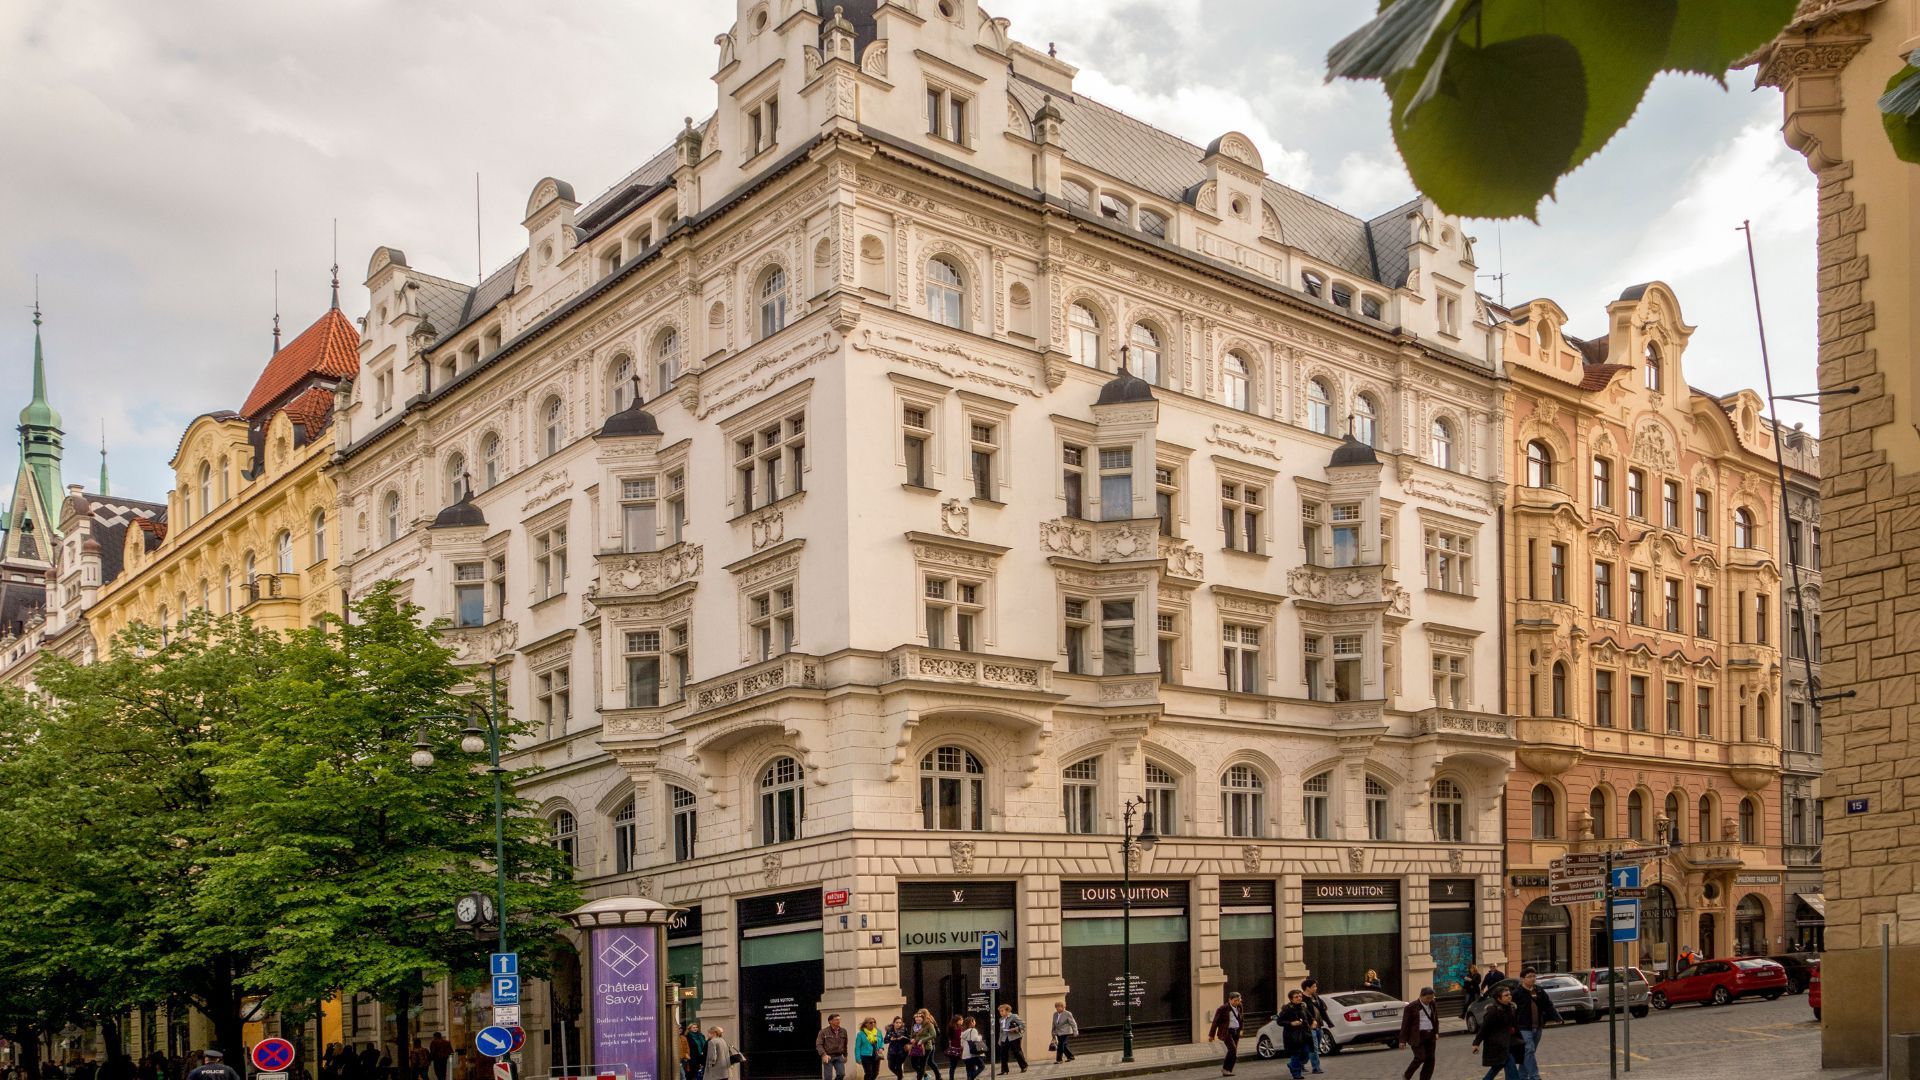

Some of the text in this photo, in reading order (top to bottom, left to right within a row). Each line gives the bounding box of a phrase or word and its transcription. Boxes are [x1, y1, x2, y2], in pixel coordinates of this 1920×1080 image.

[1851, 801, 1863, 811] 15
[1081, 887, 1169, 900] LOUIS VUITTON
[1316, 885, 1383, 897] LOUIS VUITTON
[906, 930, 1009, 945] LOUIS VUITN
[984, 938, 996, 957] P
[497, 978, 513, 997] P
[598, 982, 649, 994] Château
[605, 995, 643, 1005] Savoy
